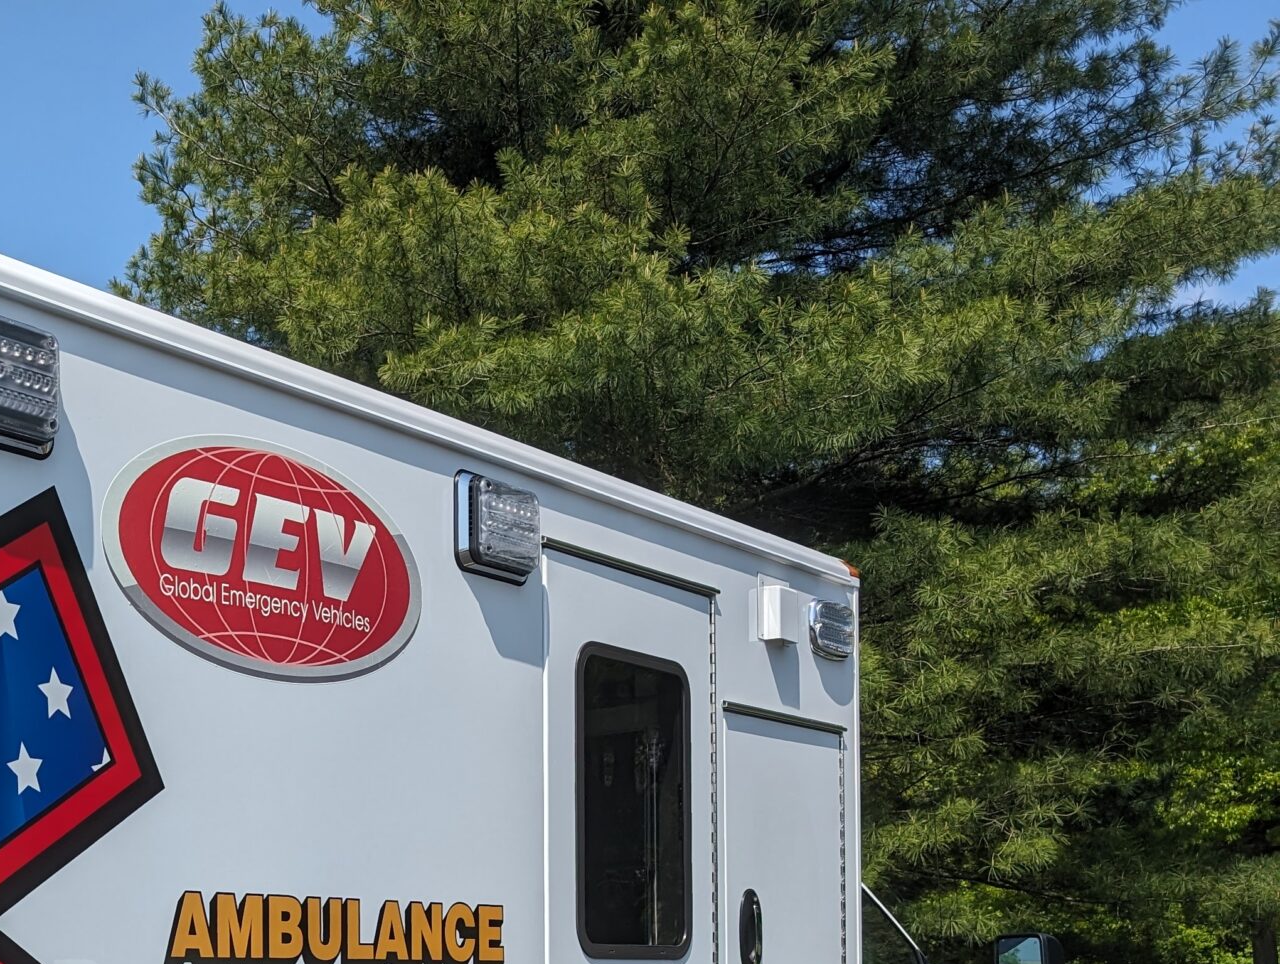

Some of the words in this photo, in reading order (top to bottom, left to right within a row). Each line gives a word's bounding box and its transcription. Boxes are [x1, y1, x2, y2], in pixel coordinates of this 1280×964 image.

[160, 476, 376, 602] GEV
[159, 572, 217, 604] Global
[221, 583, 308, 621] Emergency
[314, 600, 370, 632] Vehicles
